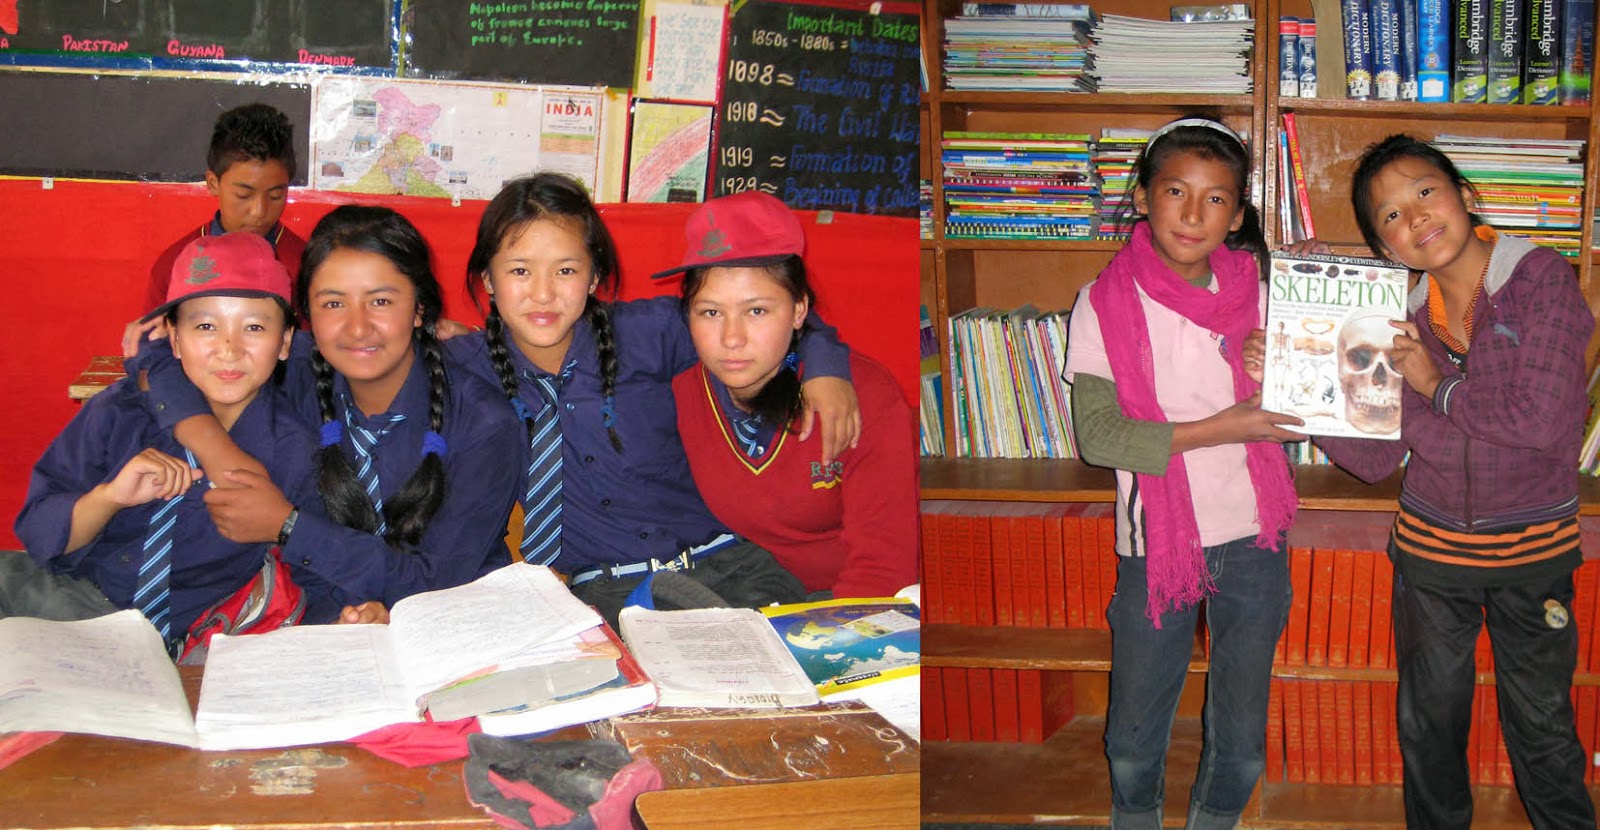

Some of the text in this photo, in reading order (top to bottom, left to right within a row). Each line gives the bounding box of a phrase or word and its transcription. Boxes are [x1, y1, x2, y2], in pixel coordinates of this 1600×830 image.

[788, 11, 918, 42] Important Dates
[1351, 1, 1362, 66] DICTIONARY
[1361, 12, 1370, 54] MODERN
[1380, 1, 1392, 67] DICTIONARY
[1391, 12, 1400, 54] MODERN
[62, 34, 129, 52] PAKISTAN
[167, 40, 224, 58] GUYANA
[298, 49, 356, 66] DENMARK
[546, 103, 592, 116] INDIA
[792, 104, 829, 134] The
[721, 146, 752, 167] 1919
[790, 144, 886, 174] Formation
[892, 152, 915, 183] of
[1272, 274, 1404, 310] SKELETON
